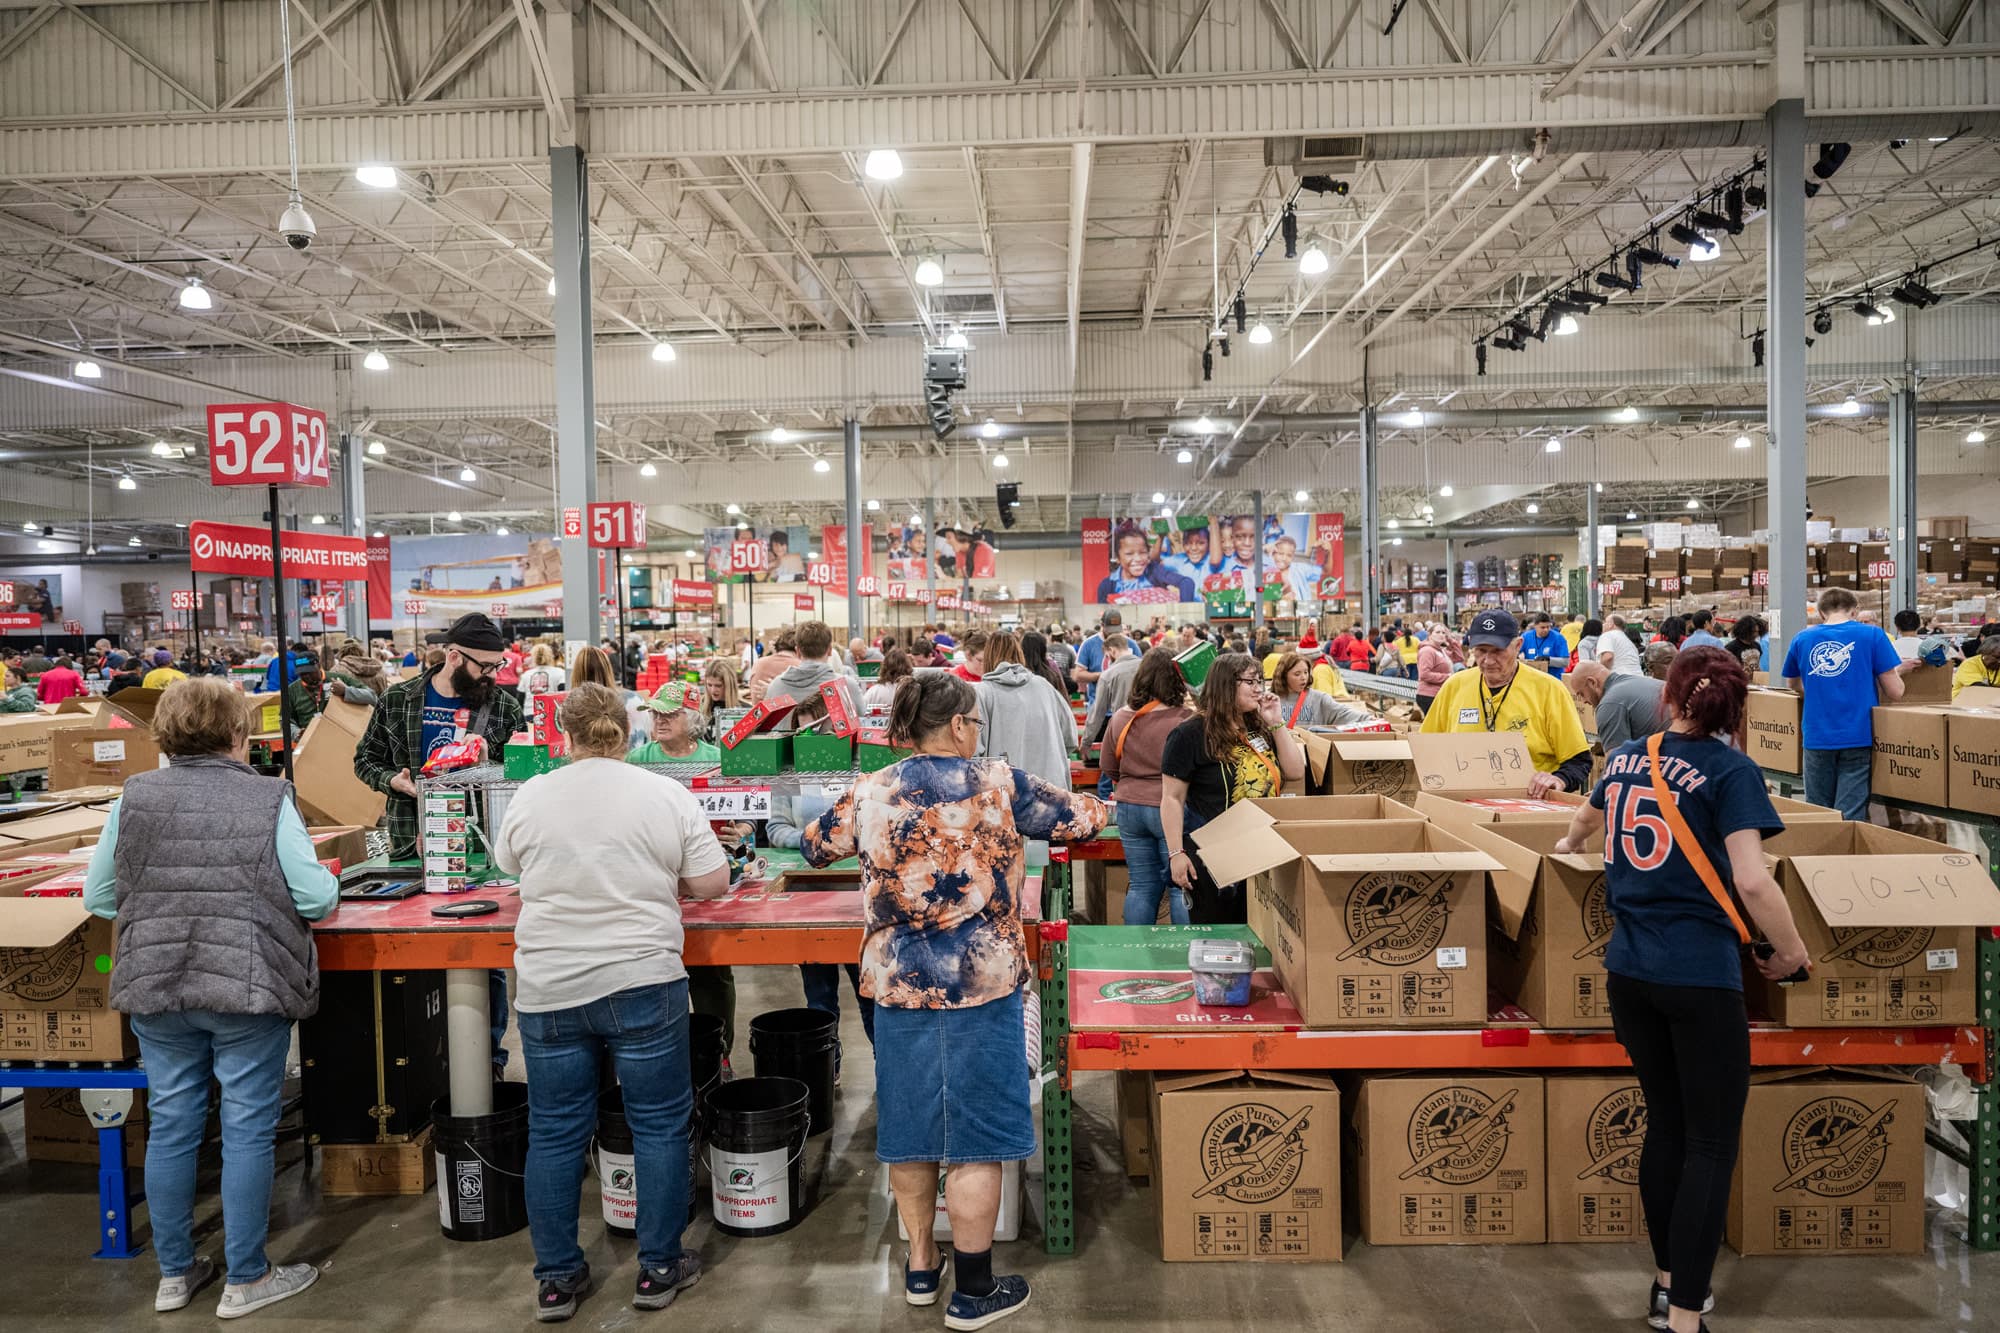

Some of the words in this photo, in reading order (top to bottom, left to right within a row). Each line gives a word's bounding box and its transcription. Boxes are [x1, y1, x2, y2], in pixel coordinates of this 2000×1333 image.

[215, 411, 285, 475] 52
[292, 412, 328, 478] 52
[594, 507, 626, 543] 51
[332, 551, 368, 567] ITEMS
[733, 543, 760, 568] 50
[810, 563, 830, 584] 49
[1879, 562, 1895, 577] 60
[858, 577, 875, 592] 48
[890, 585, 904, 597] 47
[1609, 584, 1620, 595] 57
[1668, 579, 1680, 590] 58
[172, 592, 188, 608] 35
[311, 598, 324, 611] 34
[918, 591, 930, 602] 46
[937, 596, 948, 607] 45
[405, 601, 418, 613] 33
[491, 604, 502, 615] 32
[1749, 716, 1795, 736] Samaritan's
[1760, 735, 1783, 751] Purse
[1873, 736, 1940, 761] Samaritan's
[1890, 759, 1922, 779] Purse
[1604, 782, 1680, 871] 15
[1353, 872, 1390, 939] Samaritan's
[1391, 908, 1441, 947] OPERATION
[1380, 946, 1425, 962] Christmas
[1423, 926, 1441, 949] Child
[1866, 949, 1913, 965] Christmas
[1912, 928, 1929, 951] Child
[34, 949, 77, 984] OPERATION
[1343, 978, 1355, 996] BOY
[1403, 975, 1416, 996] GIRL
[1579, 977, 1591, 995] BOY
[1827, 980, 1839, 998] BOY
[1890, 978, 1904, 999] GIRL
[47, 1012, 58, 1031] GIRL
[1176, 1014, 1212, 1022] Girl
[1219, 1014, 1254, 1022] 2-4
[1415, 1093, 1450, 1158] Samaritan's
[1452, 1089, 1486, 1110] Purse
[1594, 1093, 1630, 1158] Samaritan's
[1208, 1110, 1244, 1175] Samaritan's
[1246, 1106, 1280, 1128] Purse
[1790, 1104, 1827, 1169] Samaritan's
[1829, 1100, 1865, 1122] Purse
[1452, 1129, 1500, 1167] OPERATION
[1247, 1146, 1295, 1185] OPERATION
[1441, 1167, 1486, 1181] Christmas
[1484, 1145, 1501, 1168] Child
[1829, 1139, 1879, 1179] OPERATION
[1236, 1186, 1281, 1200] Christmas
[1279, 1163, 1296, 1186] Child
[1817, 1180, 1864, 1193] Christmas
[1862, 1157, 1880, 1180] Child
[731, 1209, 756, 1218] ITEMS
[1405, 1196, 1417, 1214] BOY
[1464, 1194, 1477, 1214] GIRL
[1583, 1196, 1596, 1214] BOY
[1199, 1215, 1211, 1233] BOY
[1260, 1213, 1272, 1233] GIRL
[1779, 1208, 1792, 1227] BOY
[1840, 1206, 1854, 1227] GIRL
